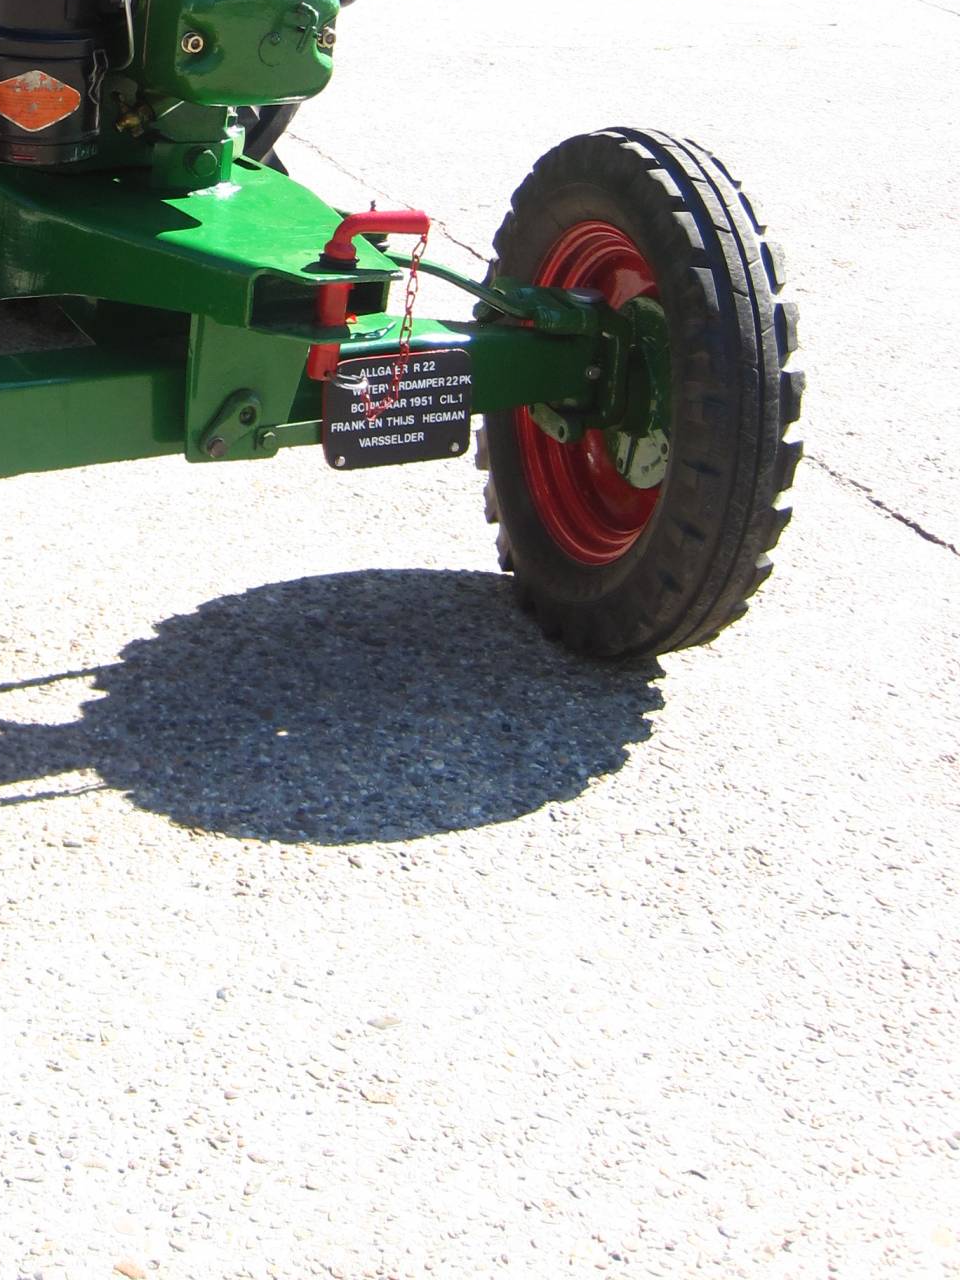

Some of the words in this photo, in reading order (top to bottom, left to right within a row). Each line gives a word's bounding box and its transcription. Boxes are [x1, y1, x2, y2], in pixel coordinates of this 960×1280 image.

[414, 364, 421, 373] R
[423, 361, 436, 372] 22
[352, 377, 445, 397] WTERRDAMPER
[410, 395, 433, 407] 1951
[331, 420, 366, 433] FRANK
[368, 417, 383, 429] EN
[386, 415, 415, 427] THIJS
[422, 410, 465, 424] HEGMAN
[358, 432, 425, 449] VARSSELDER
